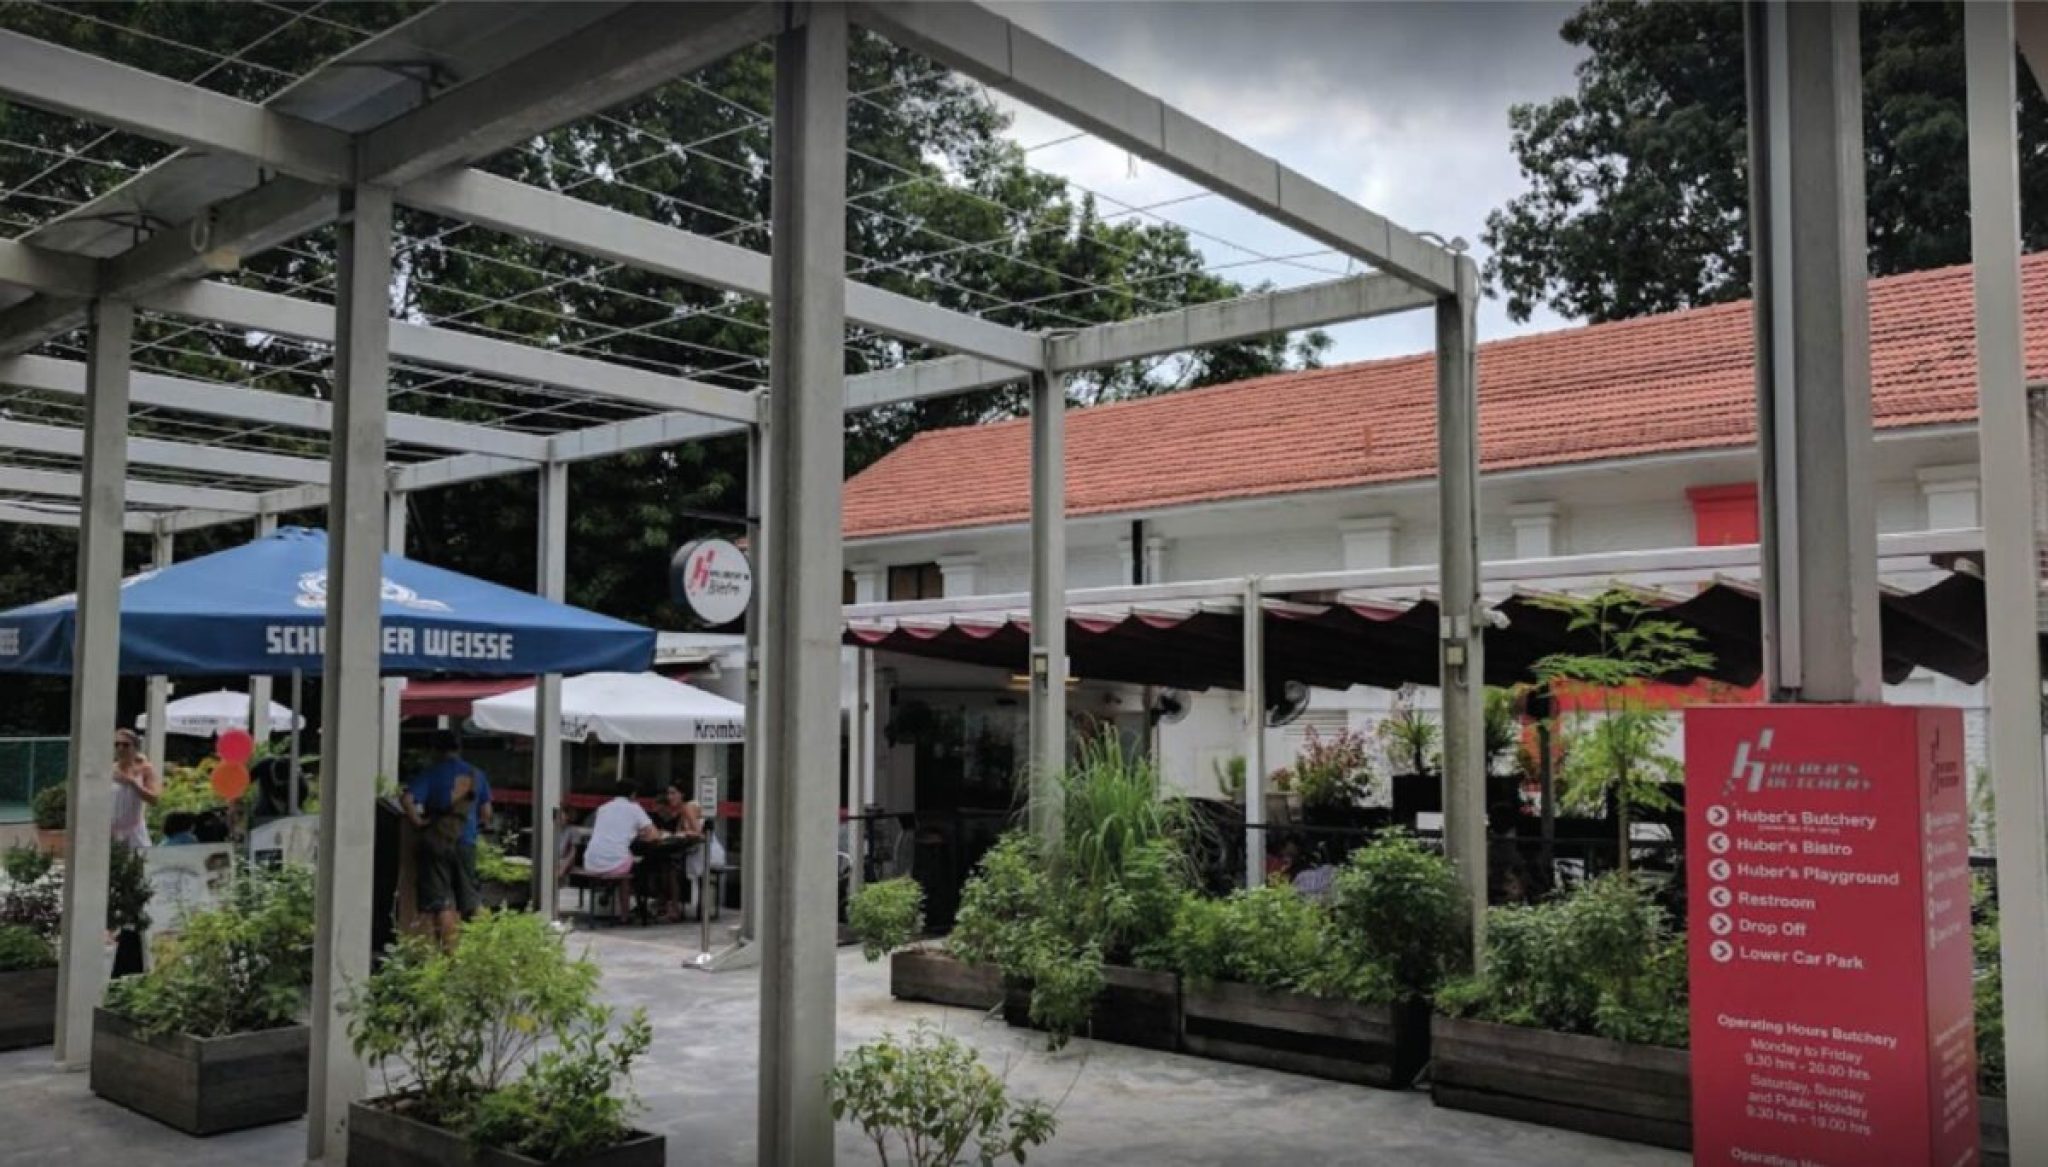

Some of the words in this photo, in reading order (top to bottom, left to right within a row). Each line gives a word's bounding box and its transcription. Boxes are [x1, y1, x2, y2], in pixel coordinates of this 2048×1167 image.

[266, 625, 415, 655] SCHER
[423, 627, 513, 660] WEISSE
[694, 717, 745, 738] Kromba
[1736, 809, 1797, 825] Huber's
[1801, 811, 1877, 830] Butchery
[1737, 838, 1798, 853] Huber's
[1802, 841, 1853, 856] Bistro
[1737, 863, 1799, 879] Huber's
[1803, 867, 1900, 886] Playground
[1738, 891, 1816, 910] Restroom
[1738, 919, 1777, 936] Drop
[1781, 922, 1808, 937] Off
[1740, 946, 1789, 962] Lower
[1792, 951, 1821, 966] Car
[1825, 953, 1864, 970] Park
[1717, 1014, 1784, 1035] Operating
[1786, 1021, 1829, 1039] Hours
[1832, 1027, 1897, 1049] Butchery
[1751, 1038, 1801, 1057] Monday
[1803, 1045, 1818, 1058] to
[1820, 1046, 1862, 1065] Friday
[1775, 1056, 1796, 1071] hrs
[1813, 1082, 1865, 1104] Sunday
[1748, 1091, 1773, 1106] and
[1775, 1093, 1816, 1111] Public
[1818, 1098, 1868, 1121] Holiday
[1776, 1107, 1798, 1124] hrs
